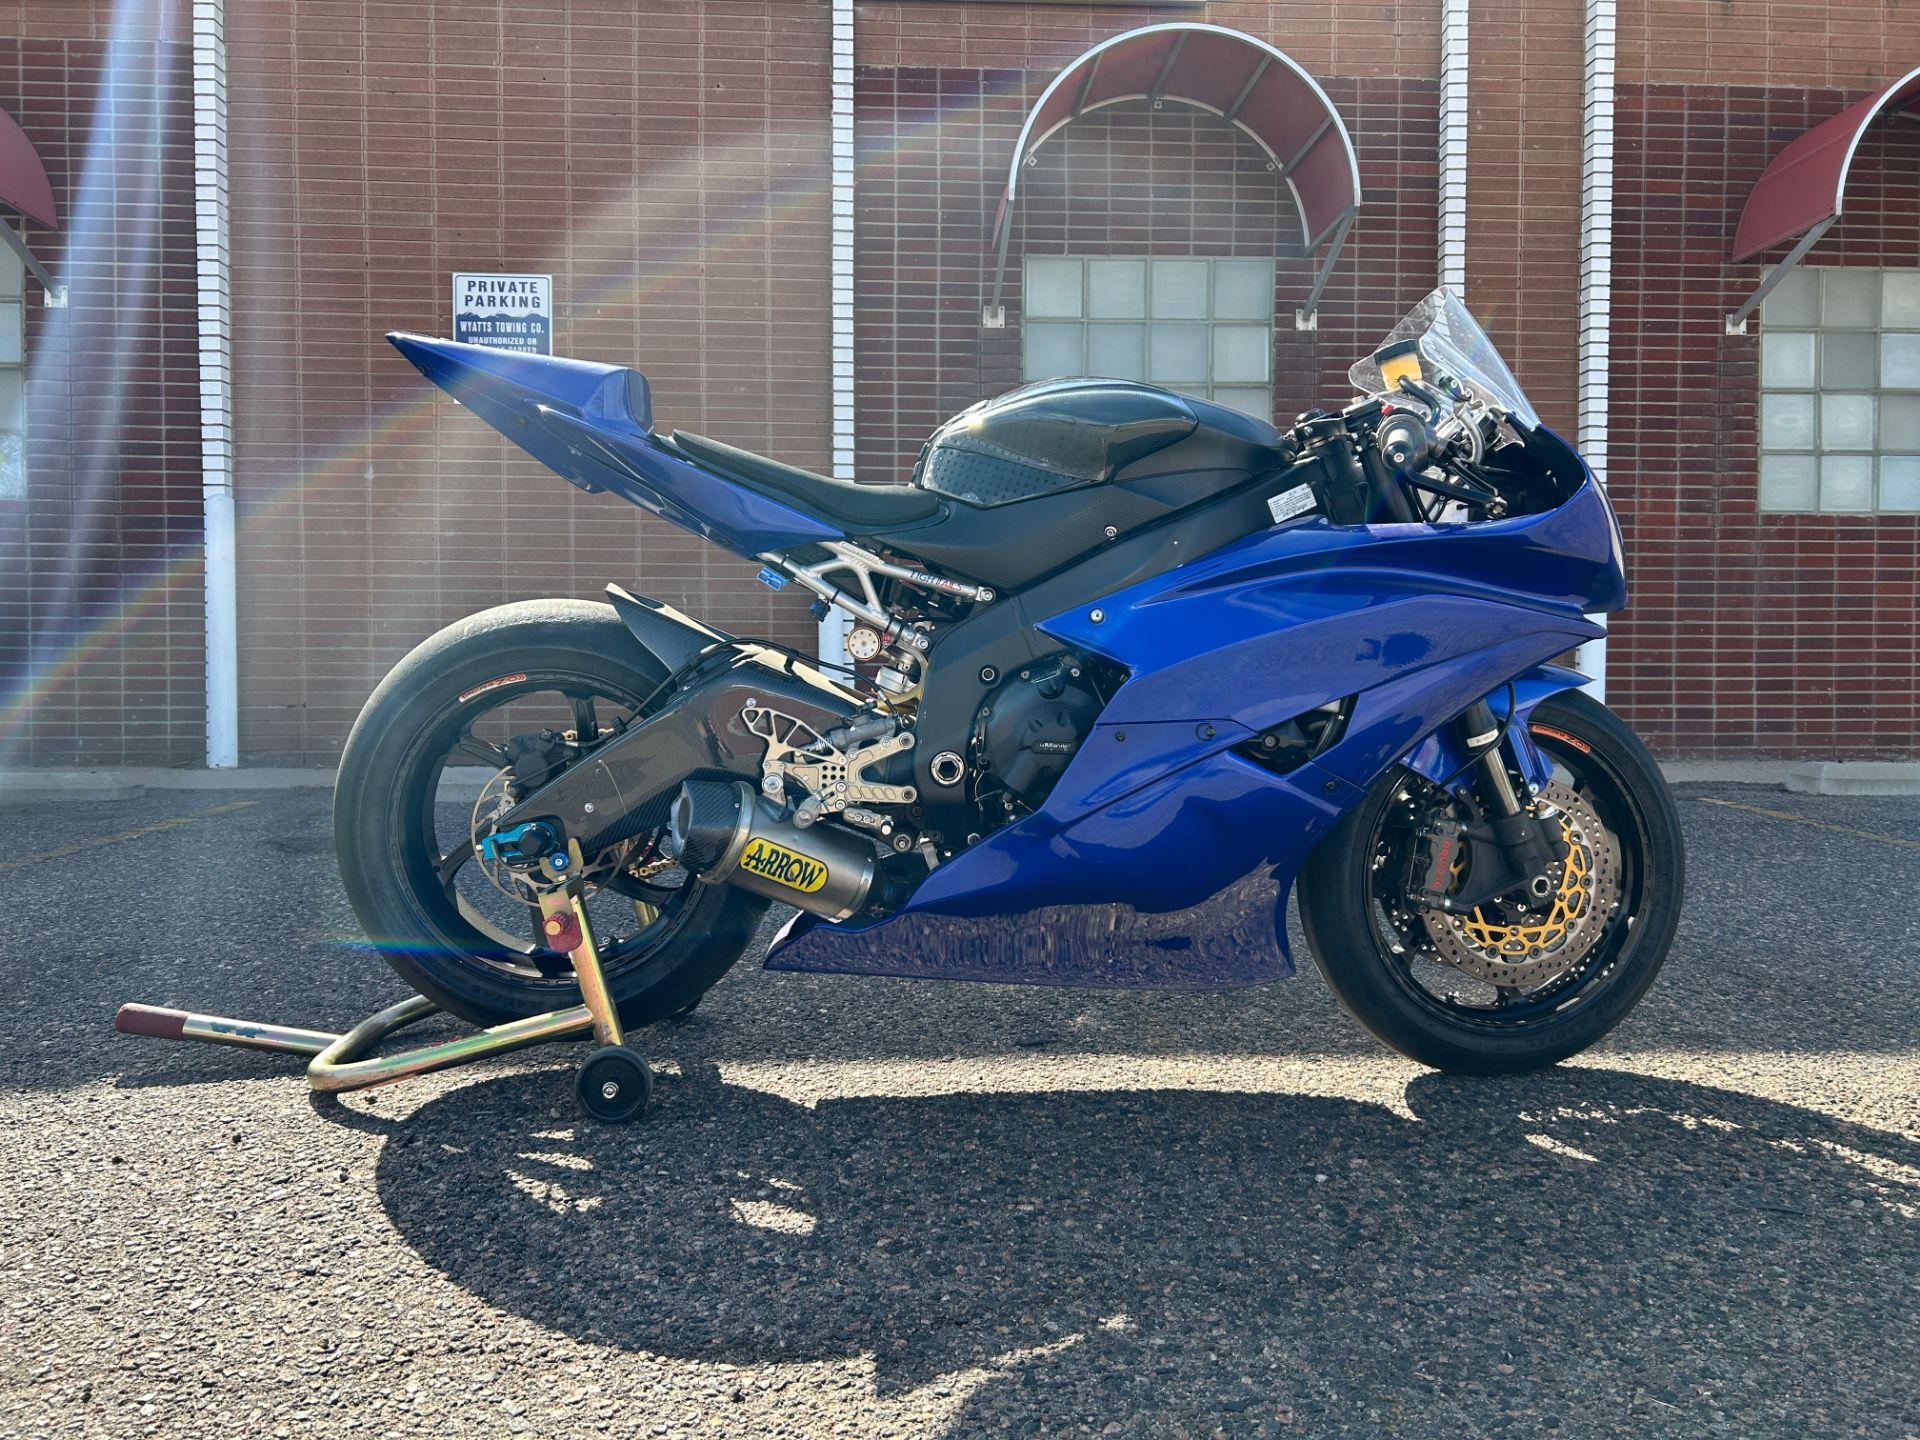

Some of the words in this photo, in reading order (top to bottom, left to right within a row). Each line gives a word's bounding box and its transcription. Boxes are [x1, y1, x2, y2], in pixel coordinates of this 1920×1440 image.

[467, 280, 538, 293] PRIVATE
[465, 295, 541, 308] PARKING
[460, 320, 492, 333] WYATTS
[496, 321, 527, 333] TOWING
[530, 322, 545, 334] CO.
[468, 336, 525, 345] UNAUTHORIZED
[527, 337, 537, 346] OR
[743, 842, 824, 889] ARROW
[1429, 839, 1451, 890] brembo
